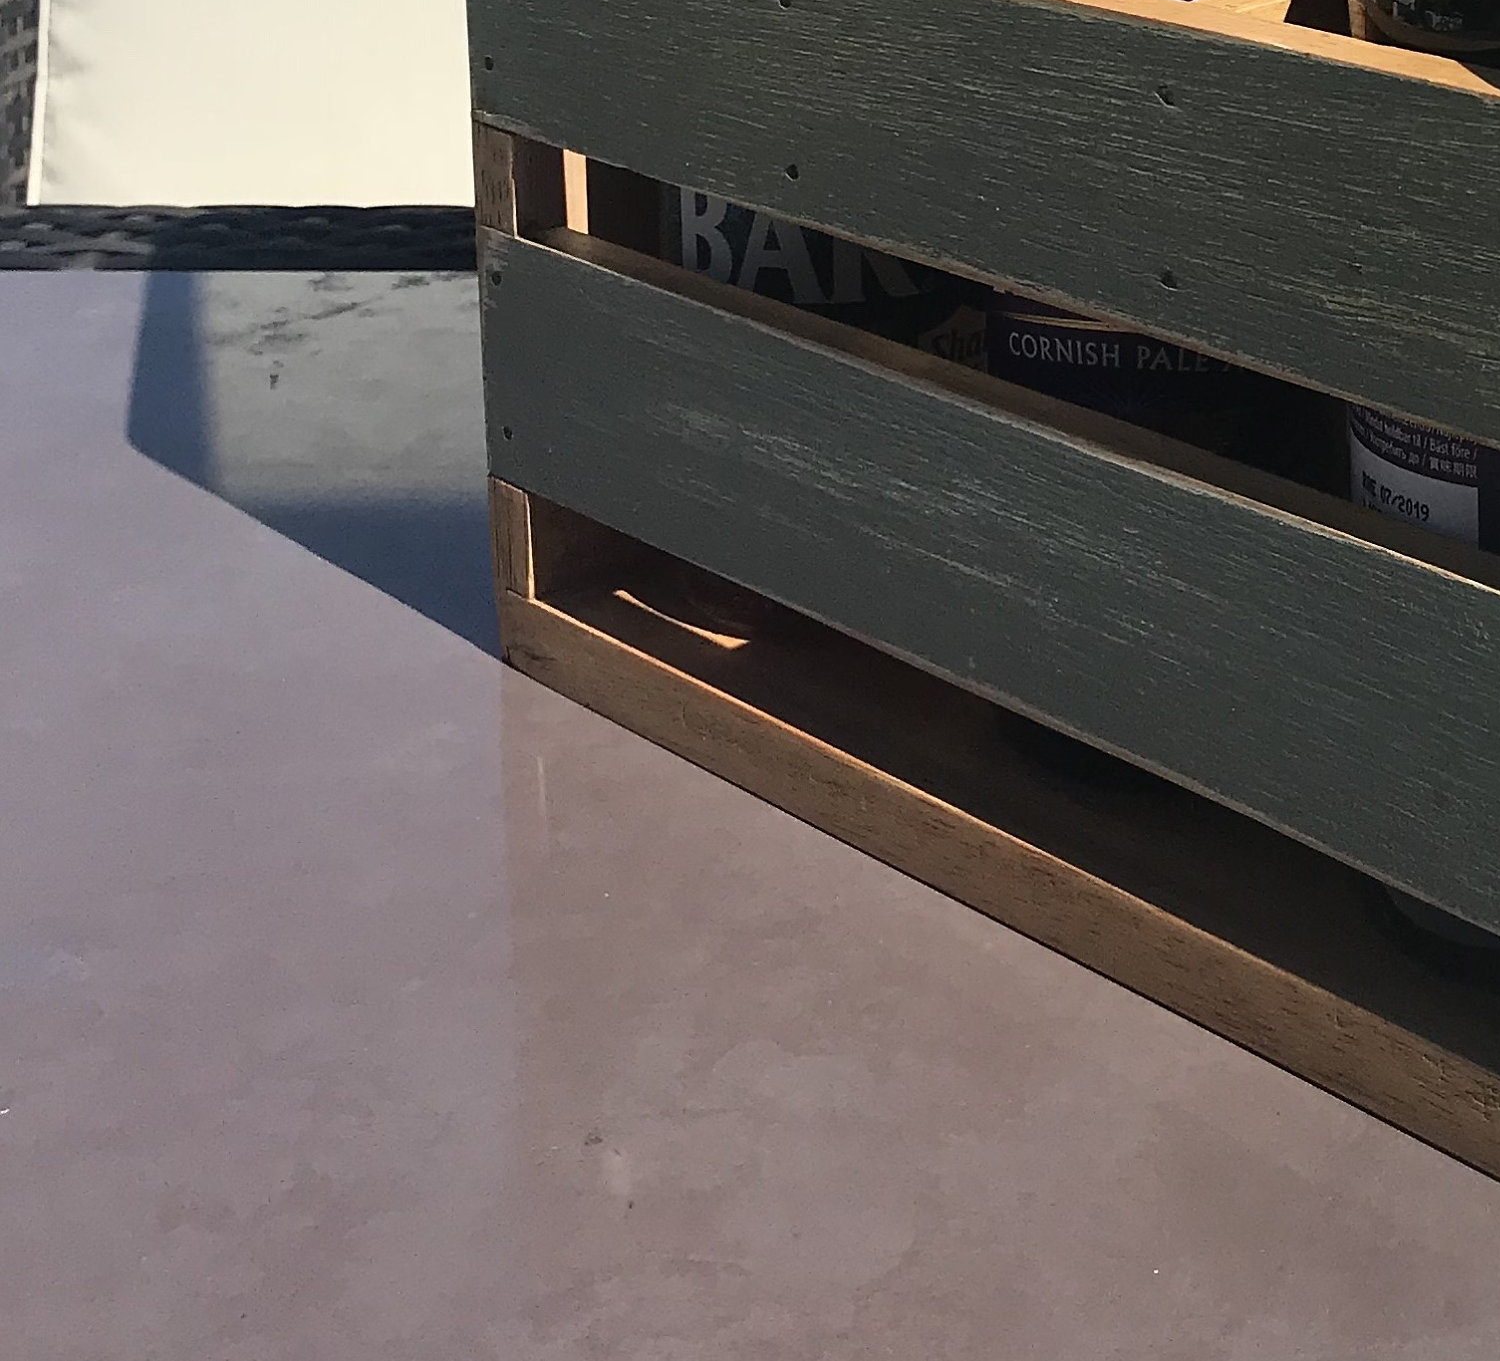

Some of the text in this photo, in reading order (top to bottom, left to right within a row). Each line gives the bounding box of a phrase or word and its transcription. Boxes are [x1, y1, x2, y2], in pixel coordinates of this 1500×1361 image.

[1008, 332, 1120, 369] CORNISH
[1136, 344, 1209, 372] PALE
[1380, 484, 1430, 522] 07/2019
